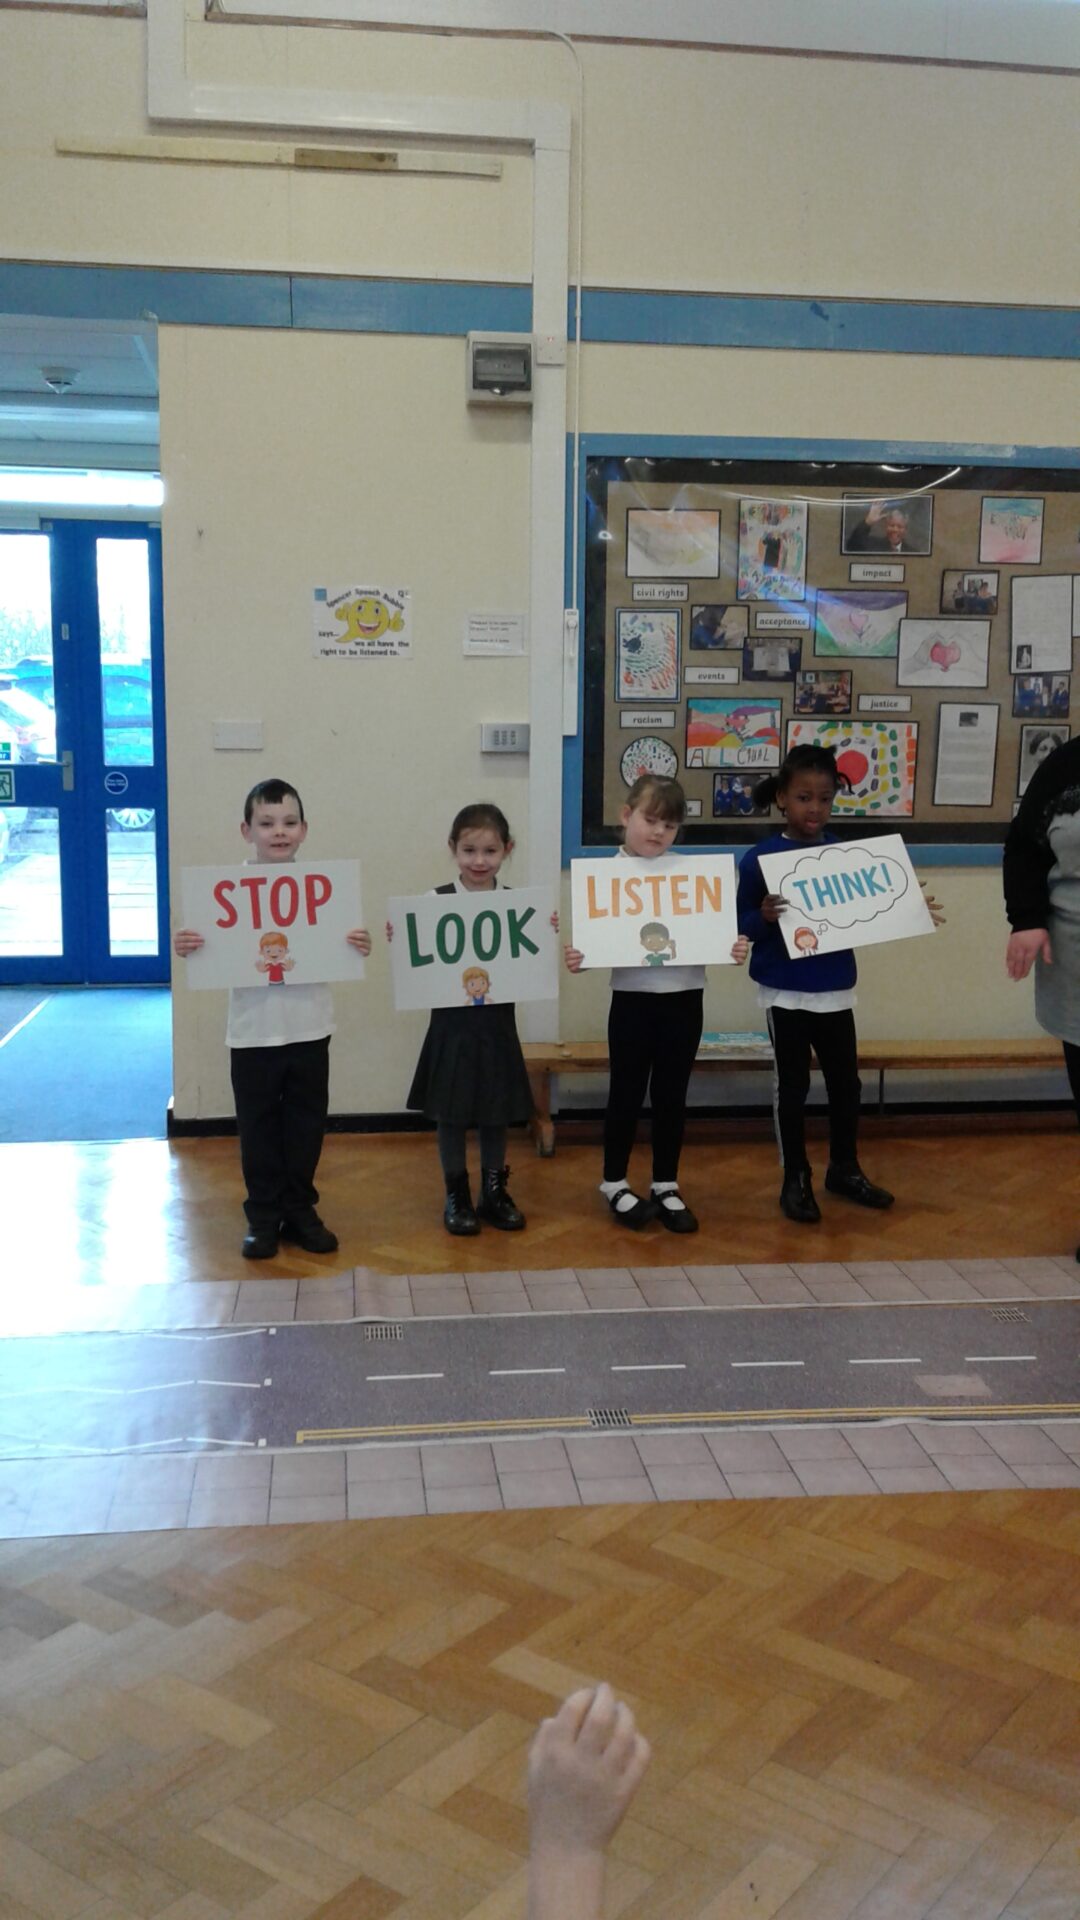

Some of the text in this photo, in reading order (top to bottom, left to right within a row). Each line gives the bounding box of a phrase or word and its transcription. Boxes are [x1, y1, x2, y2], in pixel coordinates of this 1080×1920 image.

[862, 568, 892, 579] impact
[636, 587, 685, 599] civil rights
[759, 616, 807, 627] acceptance
[320, 649, 337, 657] right
[698, 672, 725, 681] events
[870, 699, 899, 710] justice
[633, 715, 662, 724] racism
[793, 862, 895, 912] THINK!
[213, 874, 332, 930] STOP
[587, 875, 723, 920] LISTEN
[405, 906, 540, 968] LOOK
